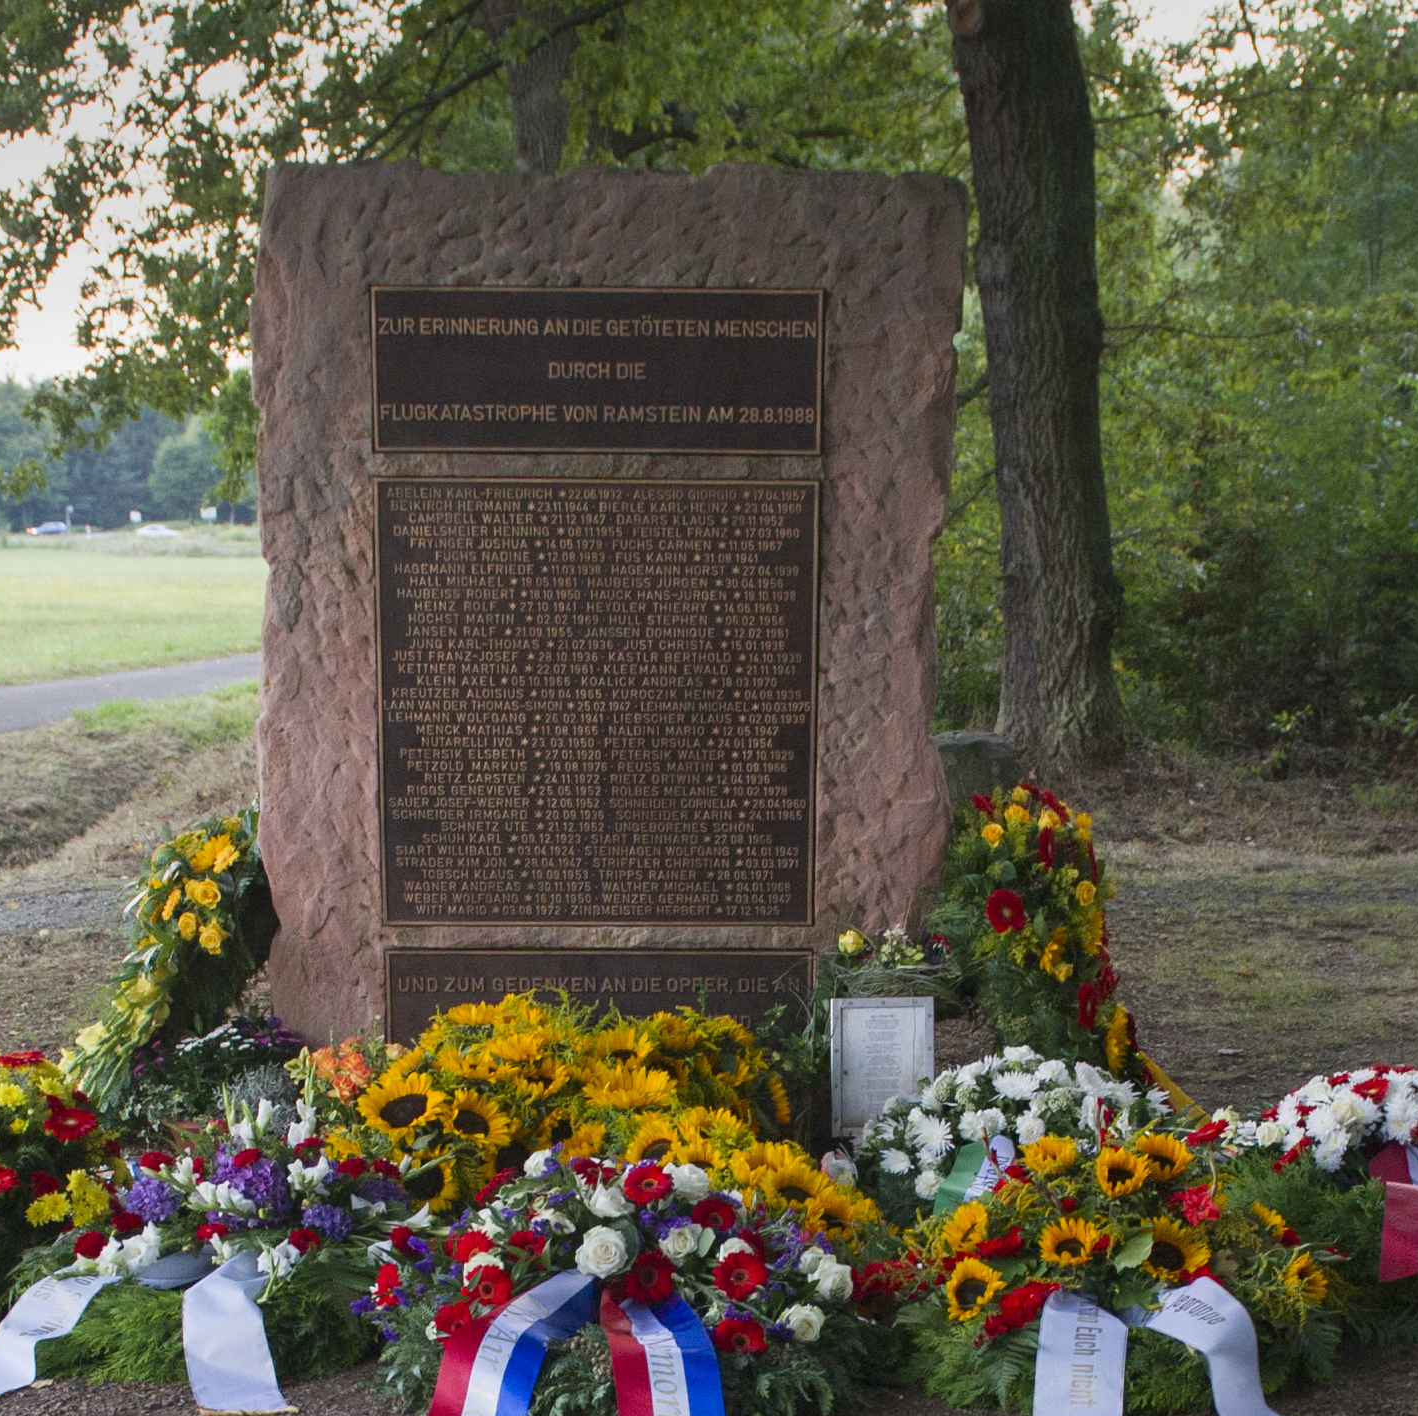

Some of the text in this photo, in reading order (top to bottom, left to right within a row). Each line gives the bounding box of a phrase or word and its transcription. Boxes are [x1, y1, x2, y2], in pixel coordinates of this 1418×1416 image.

[378, 315, 817, 339] ZUR ERINNERUNG AN DIE GETÖTETEN MENSCHEN
[548, 362, 646, 380] DURCH DIE
[380, 404, 815, 424] FLUGKATASTROPHE VON RAMSTEIN AM 28.8.1988
[386, 487, 737, 500] ABELEIN KARL-FRIEDRICH ALESSIO GIORGIO
[390, 500, 727, 512] BEIKIRCH HERMANN BIERLE KARL-HEINZ
[408, 513, 714, 525] CAMPBELL WALTER DABARS KLAUS
[392, 525, 727, 537] DANIELSMEIER HENNING FEISTEL FRANZ
[409, 538, 711, 549] FRYINGER JOSHUA FUCHS CARMEN
[435, 551, 476, 561] FUCHS
[481, 551, 529, 561] NADINE
[646, 552, 686, 562] KARIN
[393, 563, 724, 575] HAGEMANN ELFRIEDE HAGEMANN HORST
[409, 576, 441, 586] HALL
[446, 576, 503, 586] MICHAEL
[587, 577, 651, 587] HAUBEISS
[395, 588, 460, 598] HAUBEISS
[466, 589, 514, 599] ROBERT
[589, 589, 631, 599] HAUCK
[414, 601, 455, 611] HEINZ
[463, 601, 496, 611] ROLF
[652, 602, 706, 612] THIERRY
[465, 613, 514, 624] MARTIN
[647, 614, 707, 625] STEPHEN
[405, 626, 715, 637] JANSEN RALF JANSSEN DOMINIQUE
[409, 638, 713, 650] JUNG KARL-THOMAS JUST CHRISTA
[391, 650, 421, 661] JUST
[428, 651, 518, 661] FRANZ-JOSEF
[664, 651, 731, 662] BERTHOLD
[397, 663, 728, 674] KETTNER MARTINA KLEEMANN EWALD
[416, 675, 703, 686] KLEIN AXEL KOALICK ANDREAS
[391, 688, 459, 698] KREUTZER
[465, 688, 523, 698] ALOISIUS
[684, 689, 724, 699] HEINZ
[383, 700, 748, 711] LAAN VAN DER THOMAS-SIMON LEHMANN MICHAEL
[387, 712, 731, 723] LEHMANN WOLFGANG LIEBSCHER KLAUS
[415, 724, 705, 735] MENCK MATHIAS NALDINI MARIO
[493, 737, 512, 747] IVO
[603, 737, 645, 747] PETER
[651, 737, 700, 747] URSULA
[399, 748, 725, 759] PETERSIK ELSBETH PETERSIK WALTER
[406, 761, 713, 771] PETZOLD MARKUS REUSS MARTIN
[424, 773, 700, 783] RIETZ CARSTEN RIETZ ORTWIN
[406, 785, 445, 795] RIGGS
[450, 785, 520, 795] GENEVIEVE
[663, 785, 717, 796] MELANIE
[388, 797, 737, 808] SAUER JOSEF-WERNER SCHNEIDER CORNELIA
[391, 809, 731, 820] SCHNEIDER IRMGARD SCHNEIDER KARIN
[441, 821, 499, 832] SCHNETZ
[505, 821, 528, 832] UTE
[614, 821, 707, 832] UNGEBORENES
[422, 833, 698, 843] SCHUH KARL SIART REINHARD
[395, 845, 729, 855] SIART WILLIBALD STEINHAGEN WOLFGANG
[395, 857, 729, 867] STRADER KIM JON STRIFFLER CHRISTIAN
[473, 869, 513, 879] KLAUS
[598, 869, 642, 879] TRIPPS
[648, 869, 696, 879] RAINER
[403, 881, 718, 891] WAGNER ANDREAS WALTHER MICHAEL
[403, 893, 718, 903] WEBER WOLFGANG WENZEL GERHARD
[415, 905, 443, 915] WITT
[447, 905, 487, 915] MARIO
[656, 905, 710, 915] HERBERT
[398, 977, 439, 992] UND
[444, 977, 485, 992] ZUM
[493, 977, 596, 993] GEDENKEN
[601, 978, 626, 992] AN
[632, 978, 661, 993] DIE
[738, 978, 768, 993] DIE
[774, 978, 800, 992] AN
[1073, 1326, 1102, 1356] Euch
[1070, 1364, 1097, 1408] nicht
